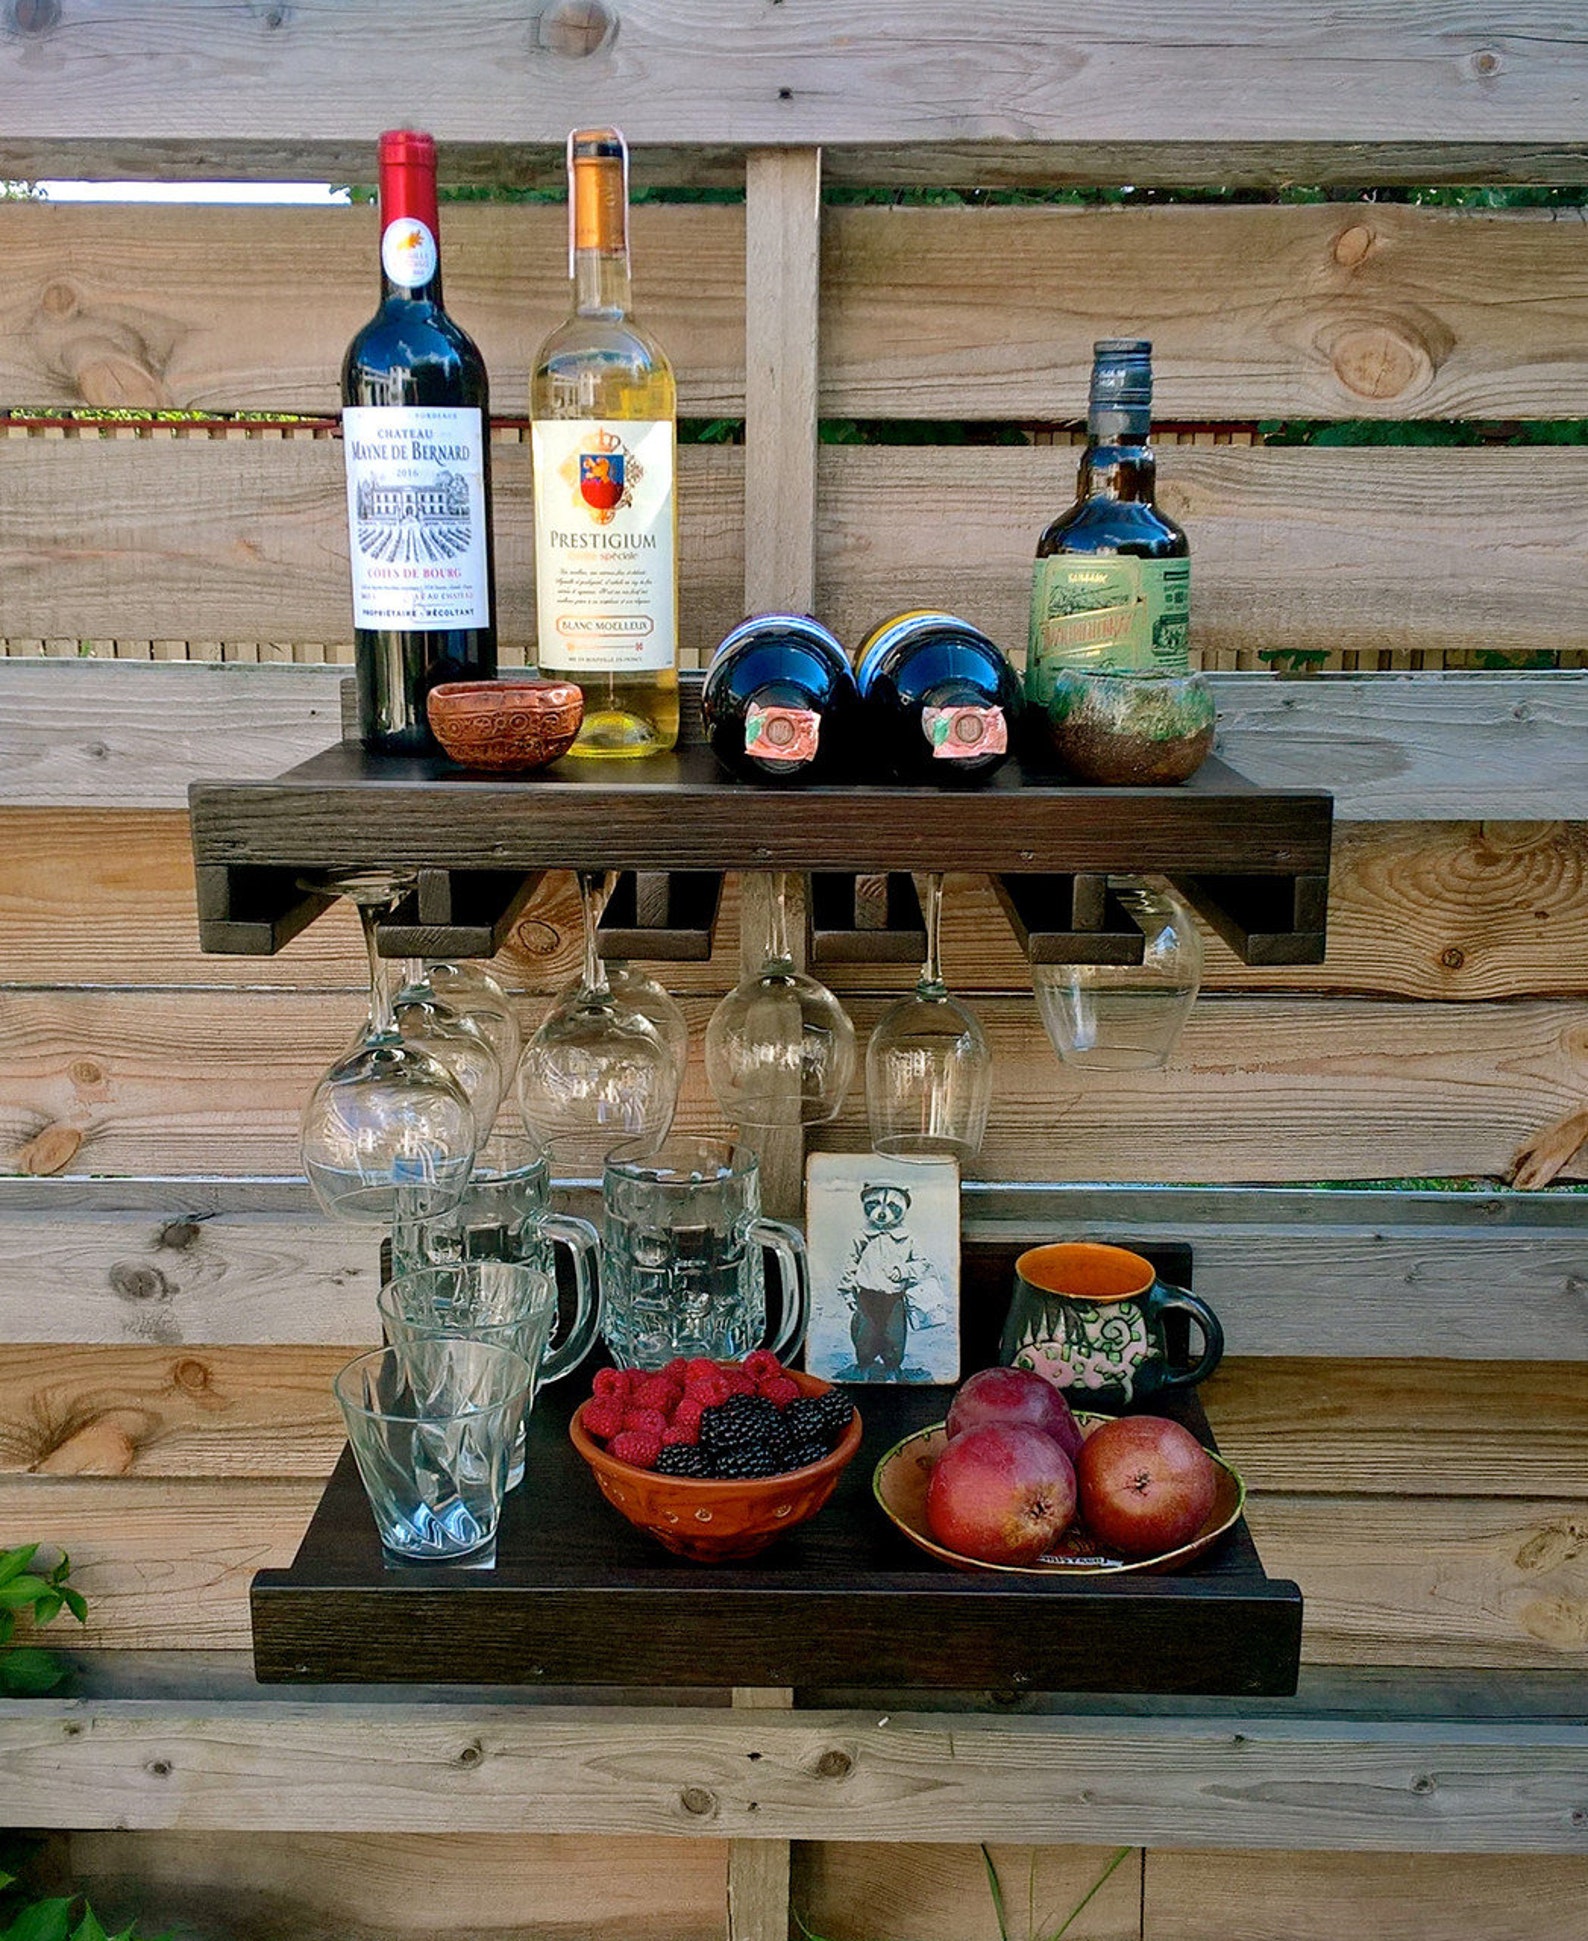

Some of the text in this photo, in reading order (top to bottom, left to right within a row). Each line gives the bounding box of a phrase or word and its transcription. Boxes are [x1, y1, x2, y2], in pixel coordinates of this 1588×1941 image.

[351, 441, 470, 467] MAYNE DE BERNARD
[397, 468, 419, 477] 2016
[550, 530, 657, 549] PRESTIGIUM
[403, 567, 419, 578] DE
[423, 567, 462, 578] BOURG
[562, 621, 593, 630] BLANC
